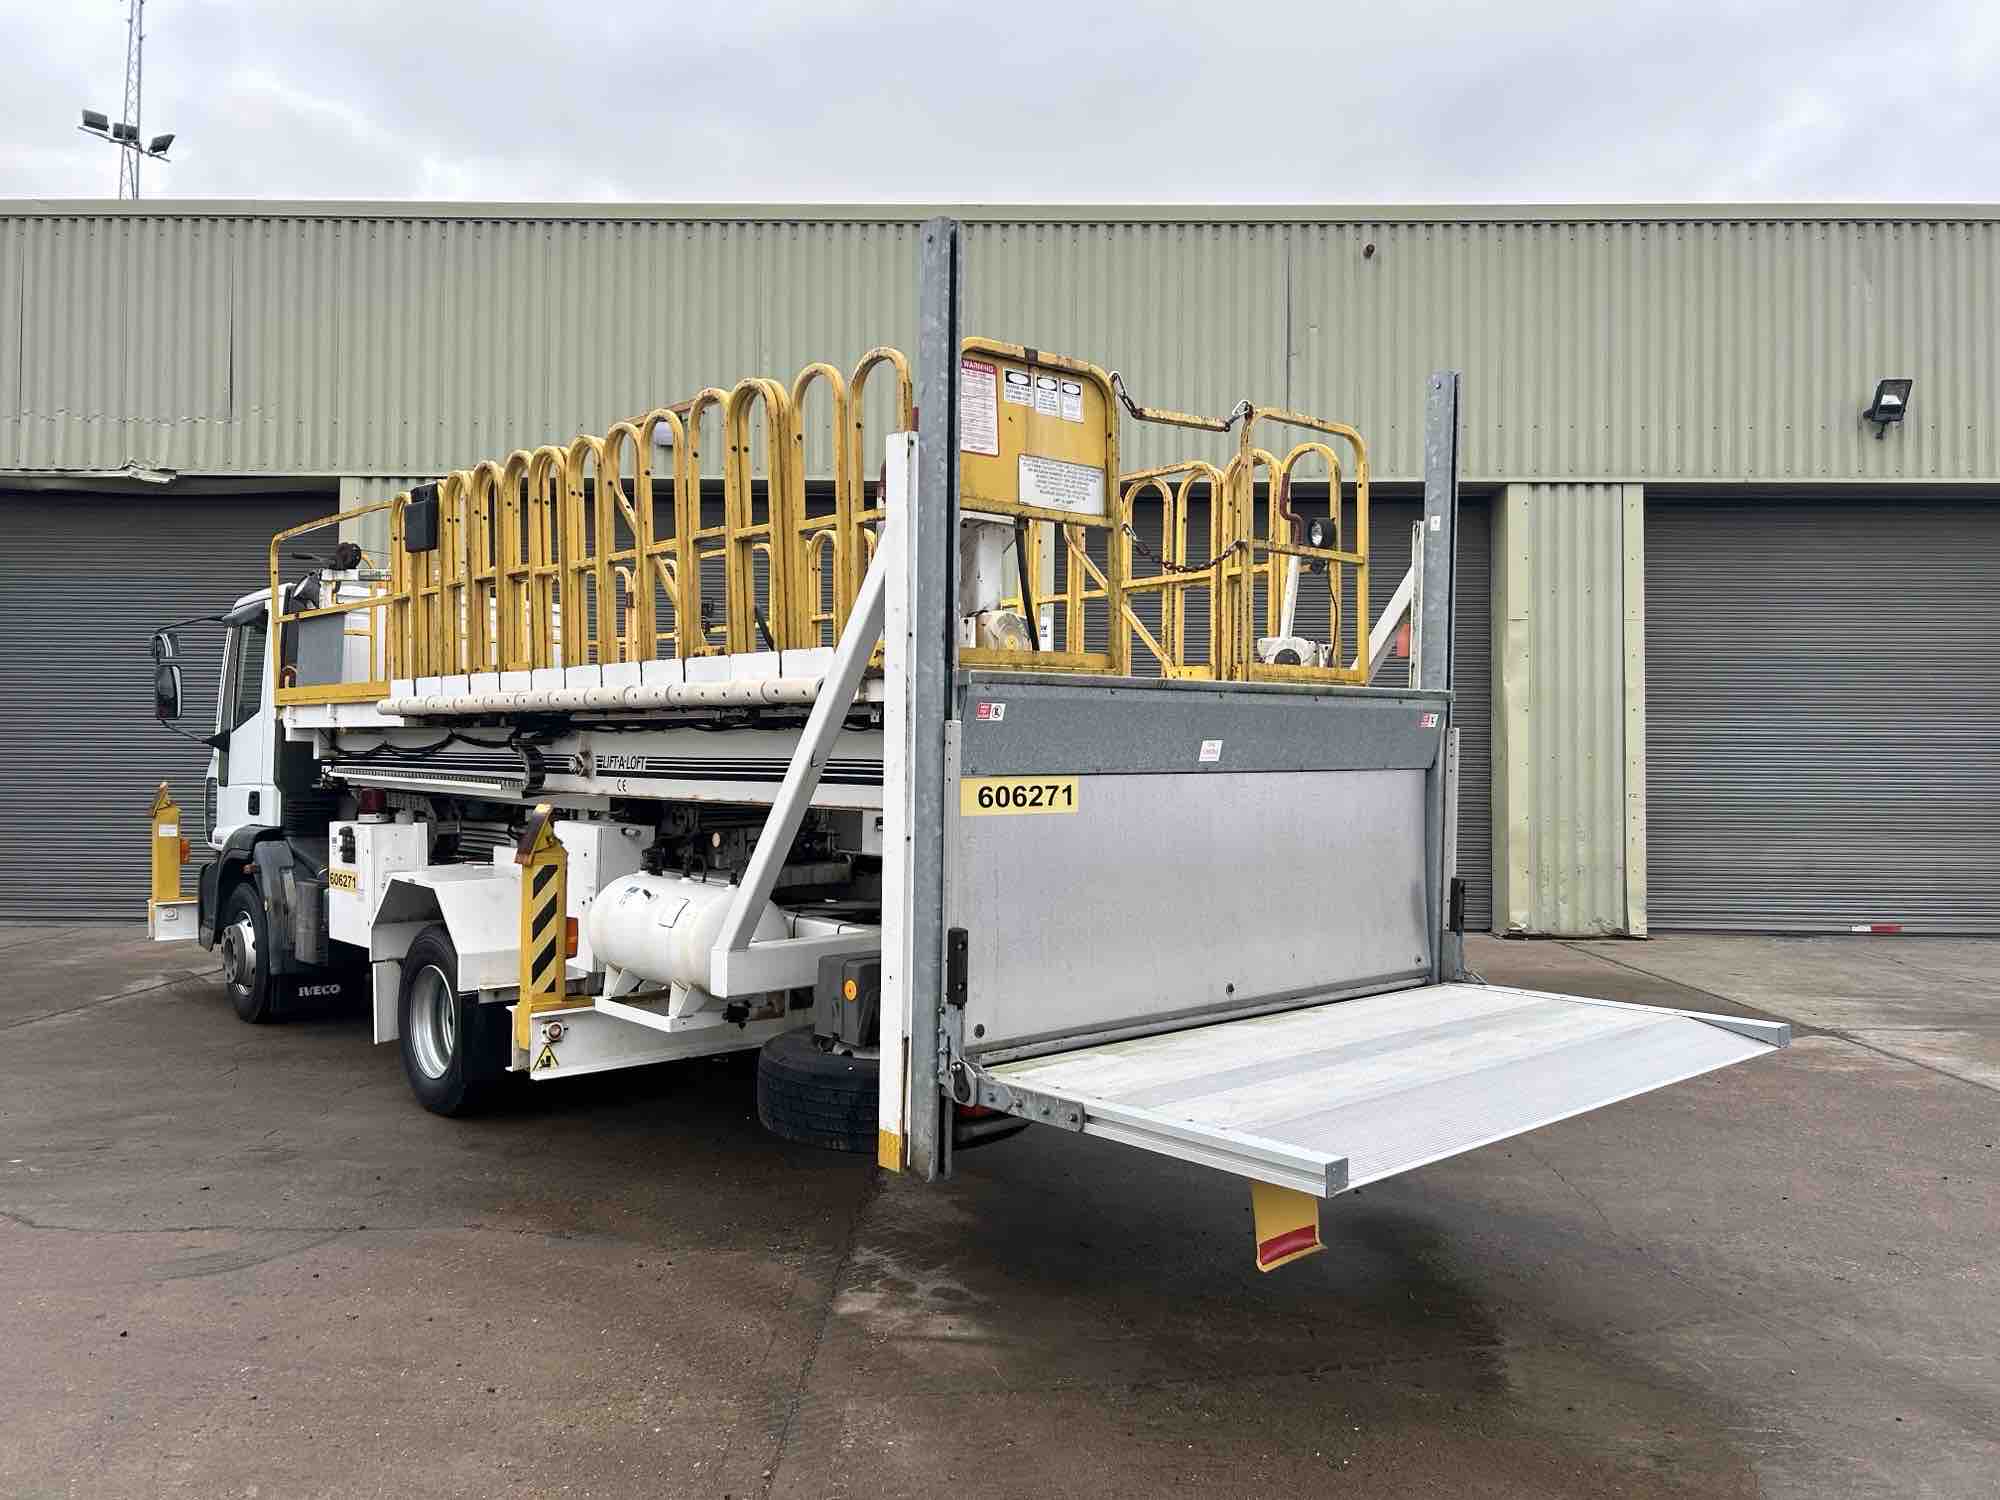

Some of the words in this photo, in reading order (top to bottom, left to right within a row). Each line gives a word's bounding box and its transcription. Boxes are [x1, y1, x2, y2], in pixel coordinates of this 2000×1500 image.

[977, 784, 1073, 808] 606271
[329, 872, 357, 889] 606271
[298, 983, 342, 997] IVECO
